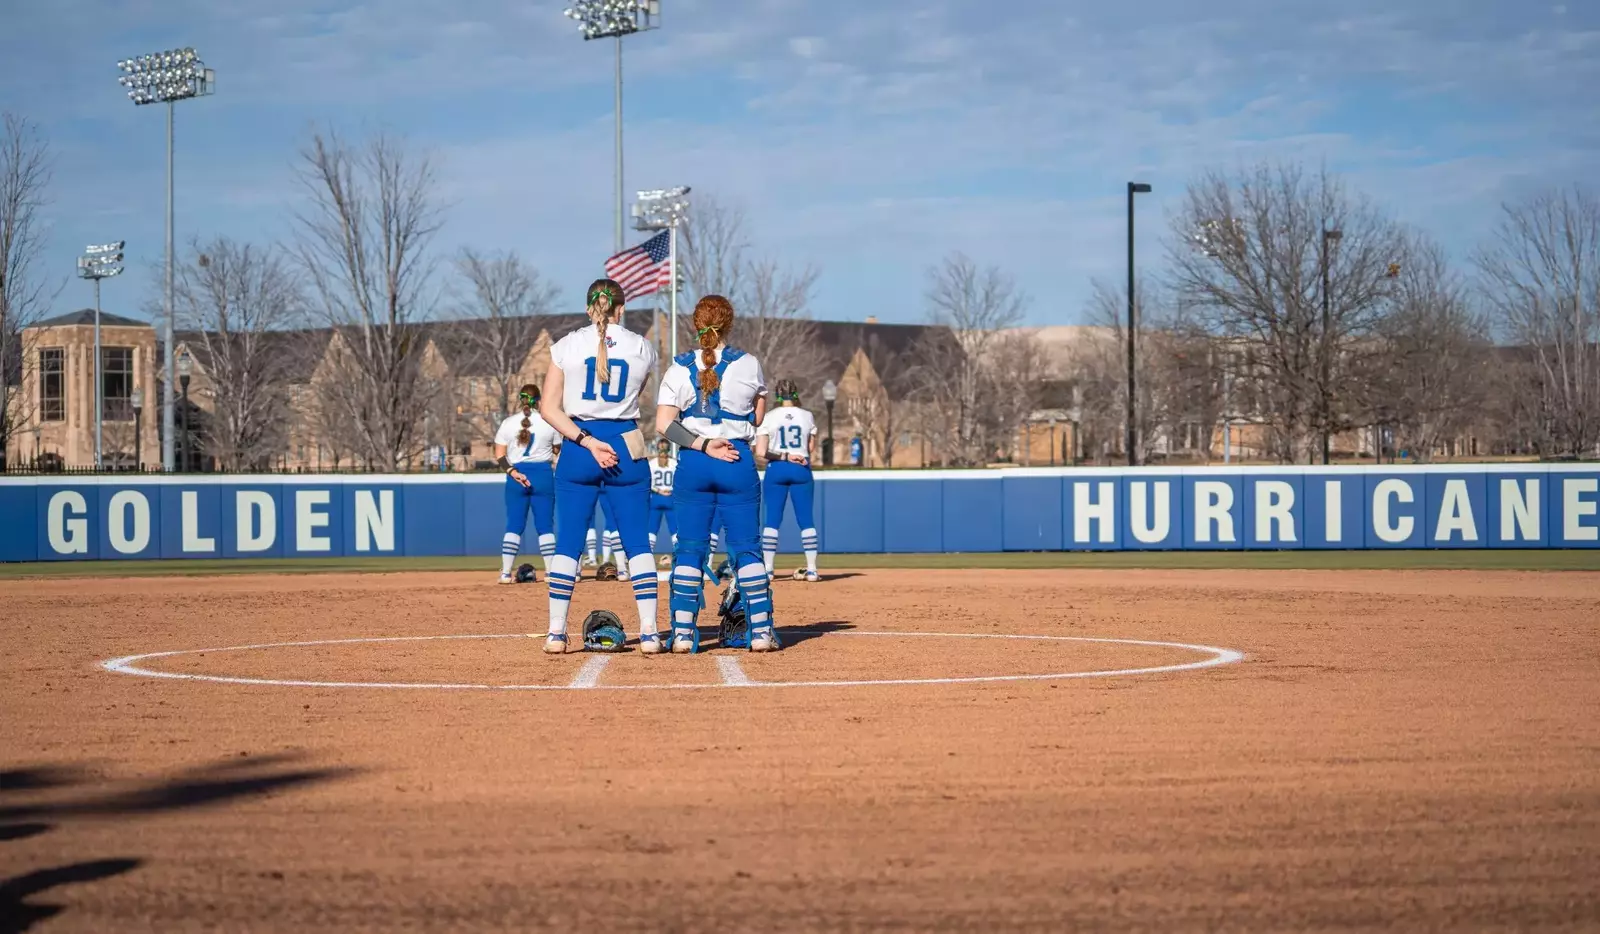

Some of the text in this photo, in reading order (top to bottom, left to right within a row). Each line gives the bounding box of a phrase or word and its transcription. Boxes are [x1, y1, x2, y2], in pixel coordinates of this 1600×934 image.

[581, 356, 629, 403] 10
[779, 425, 801, 449] 13
[654, 470, 674, 487] 20
[47, 490, 395, 554] GOLDEN
[1073, 478, 1598, 542] HURRICANE
